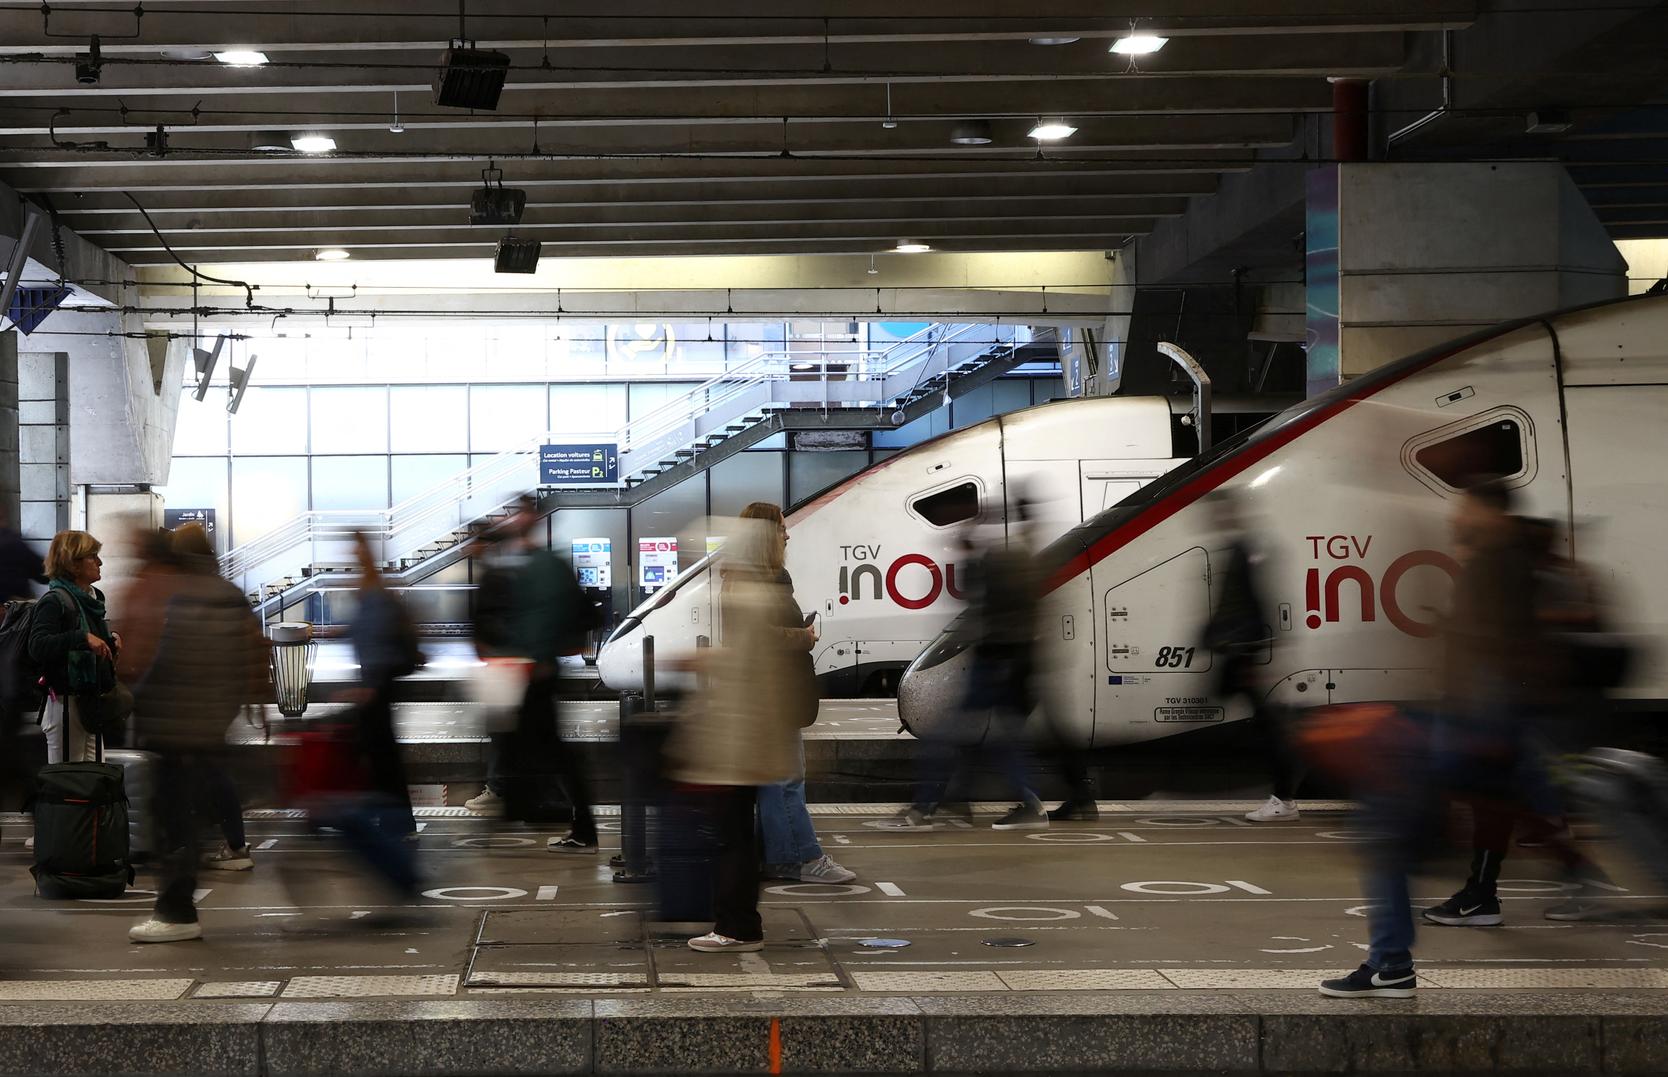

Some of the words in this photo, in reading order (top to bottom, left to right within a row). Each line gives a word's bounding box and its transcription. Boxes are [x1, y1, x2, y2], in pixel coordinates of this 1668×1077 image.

[839, 544, 881, 560] TGV
[1306, 534, 1373, 560] TGV
[1305, 549, 1463, 638] inO
[1155, 646, 1195, 668] 851
